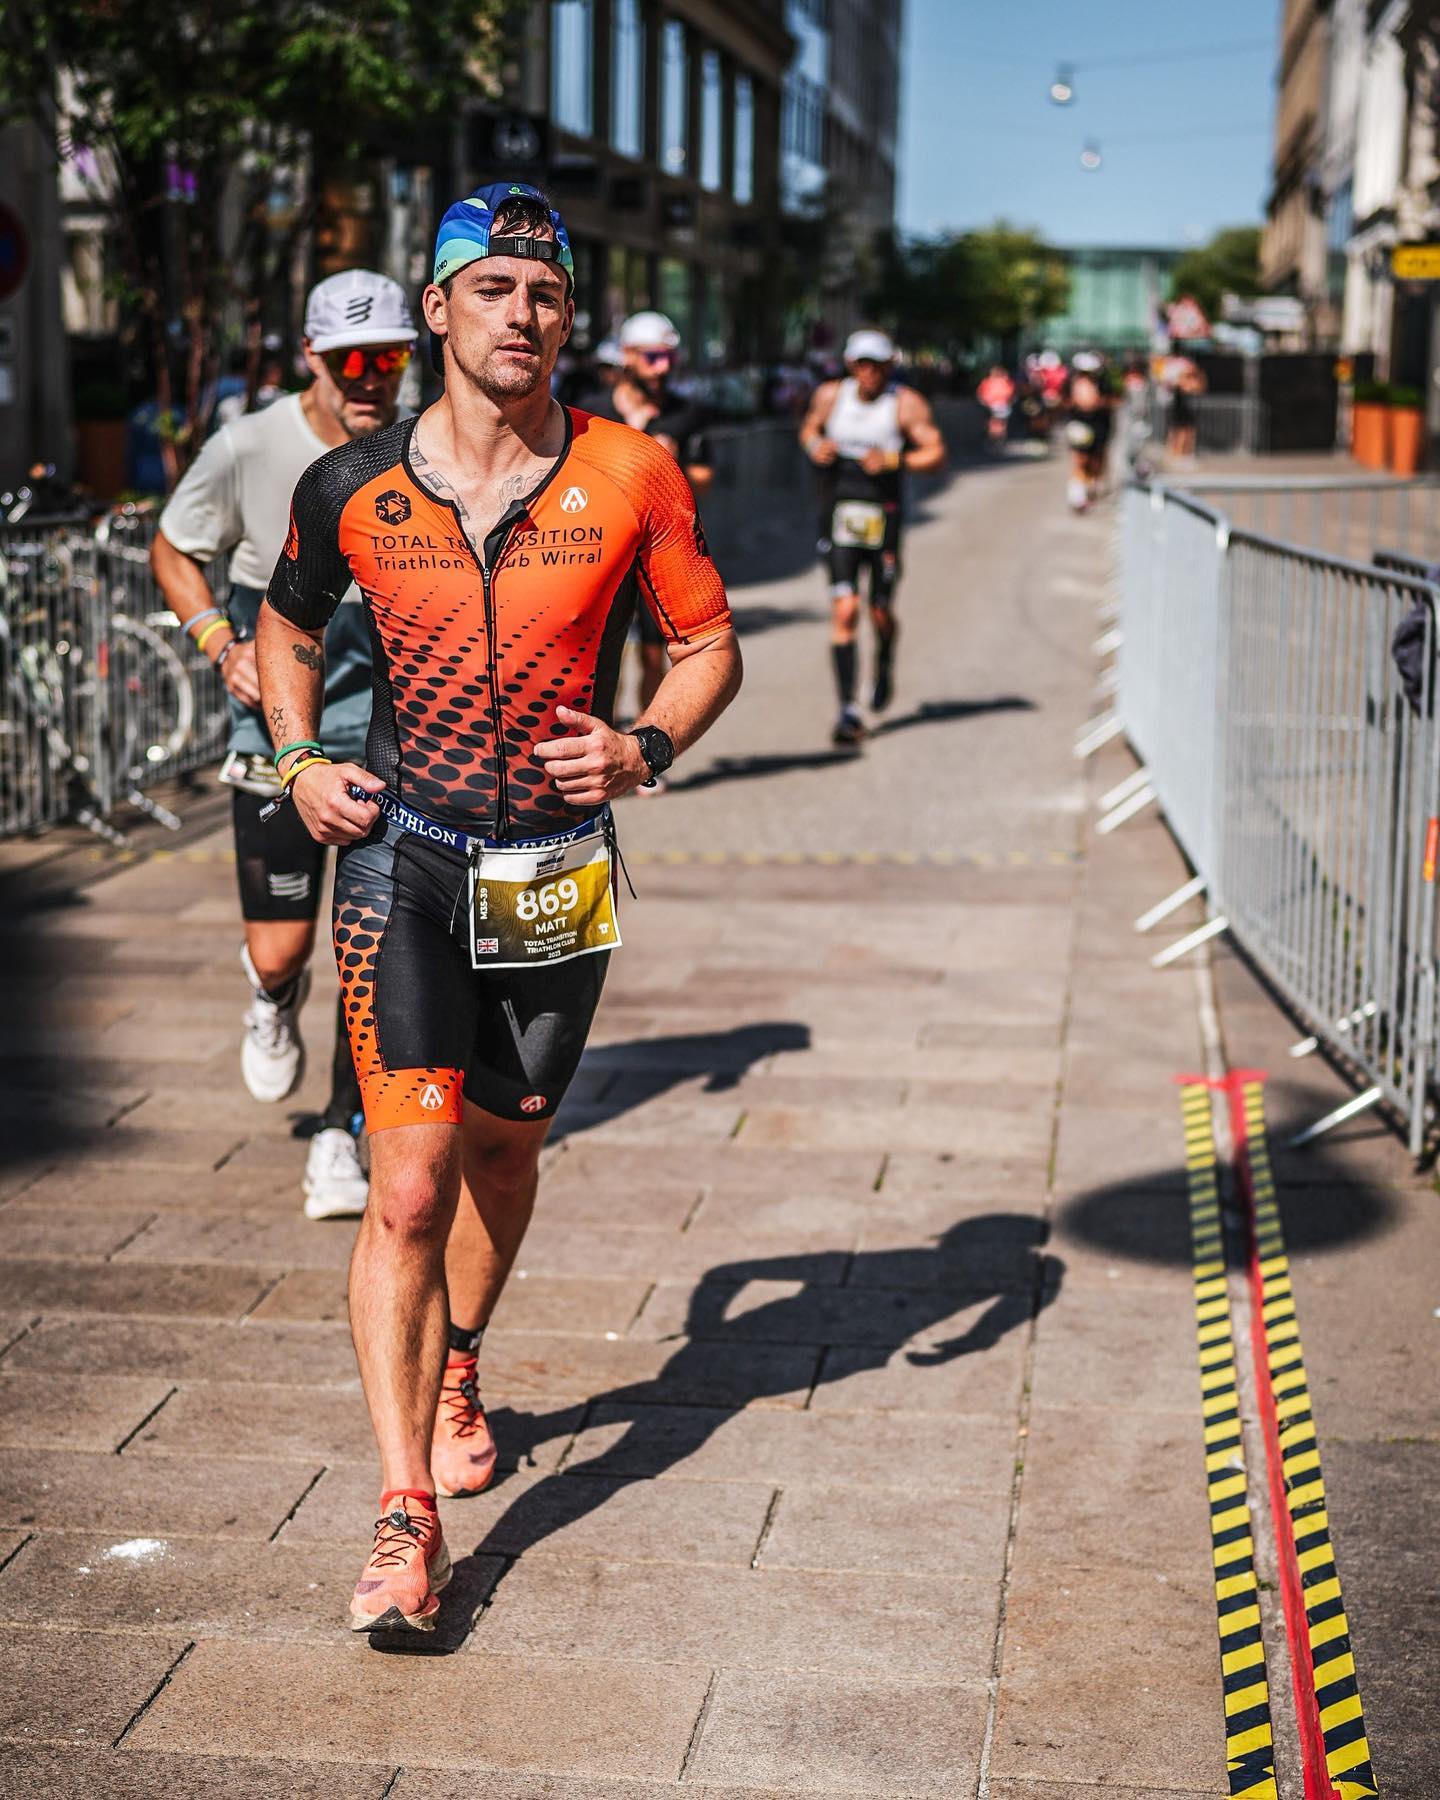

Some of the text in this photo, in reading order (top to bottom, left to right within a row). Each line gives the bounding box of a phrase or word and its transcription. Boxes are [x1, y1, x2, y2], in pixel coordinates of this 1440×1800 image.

[370, 526, 603, 550] TOTAL TRNSITION
[374, 555, 465, 571] Triathlon
[541, 548, 602, 566] Wirral
[480, 887, 488, 920] M35-39
[516, 878, 579, 921] 869
[536, 916, 568, 935] MATT
[523, 930, 578, 949] TOTAL TRANSITION
[526, 937, 576, 954] TRIATHLON CLUB
